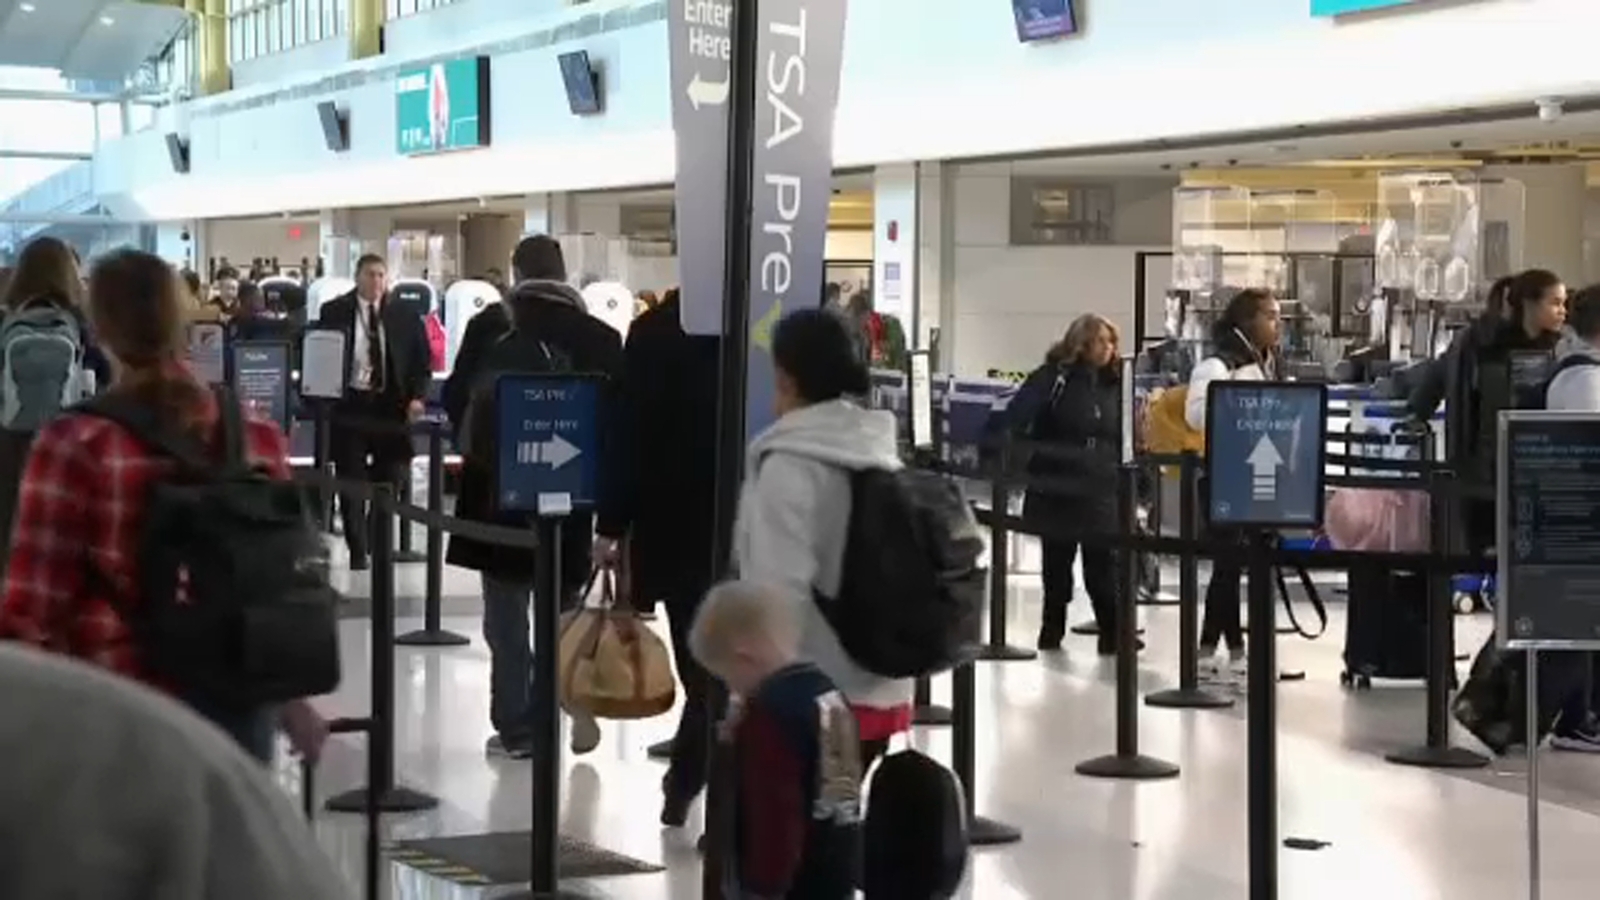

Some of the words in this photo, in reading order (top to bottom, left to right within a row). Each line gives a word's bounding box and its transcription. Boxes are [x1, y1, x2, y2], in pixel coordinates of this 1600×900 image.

[684, 0, 733, 28] Enter
[689, 26, 731, 60] Here
[766, 9, 806, 149] TSA
[761, 173, 801, 294] Pre
